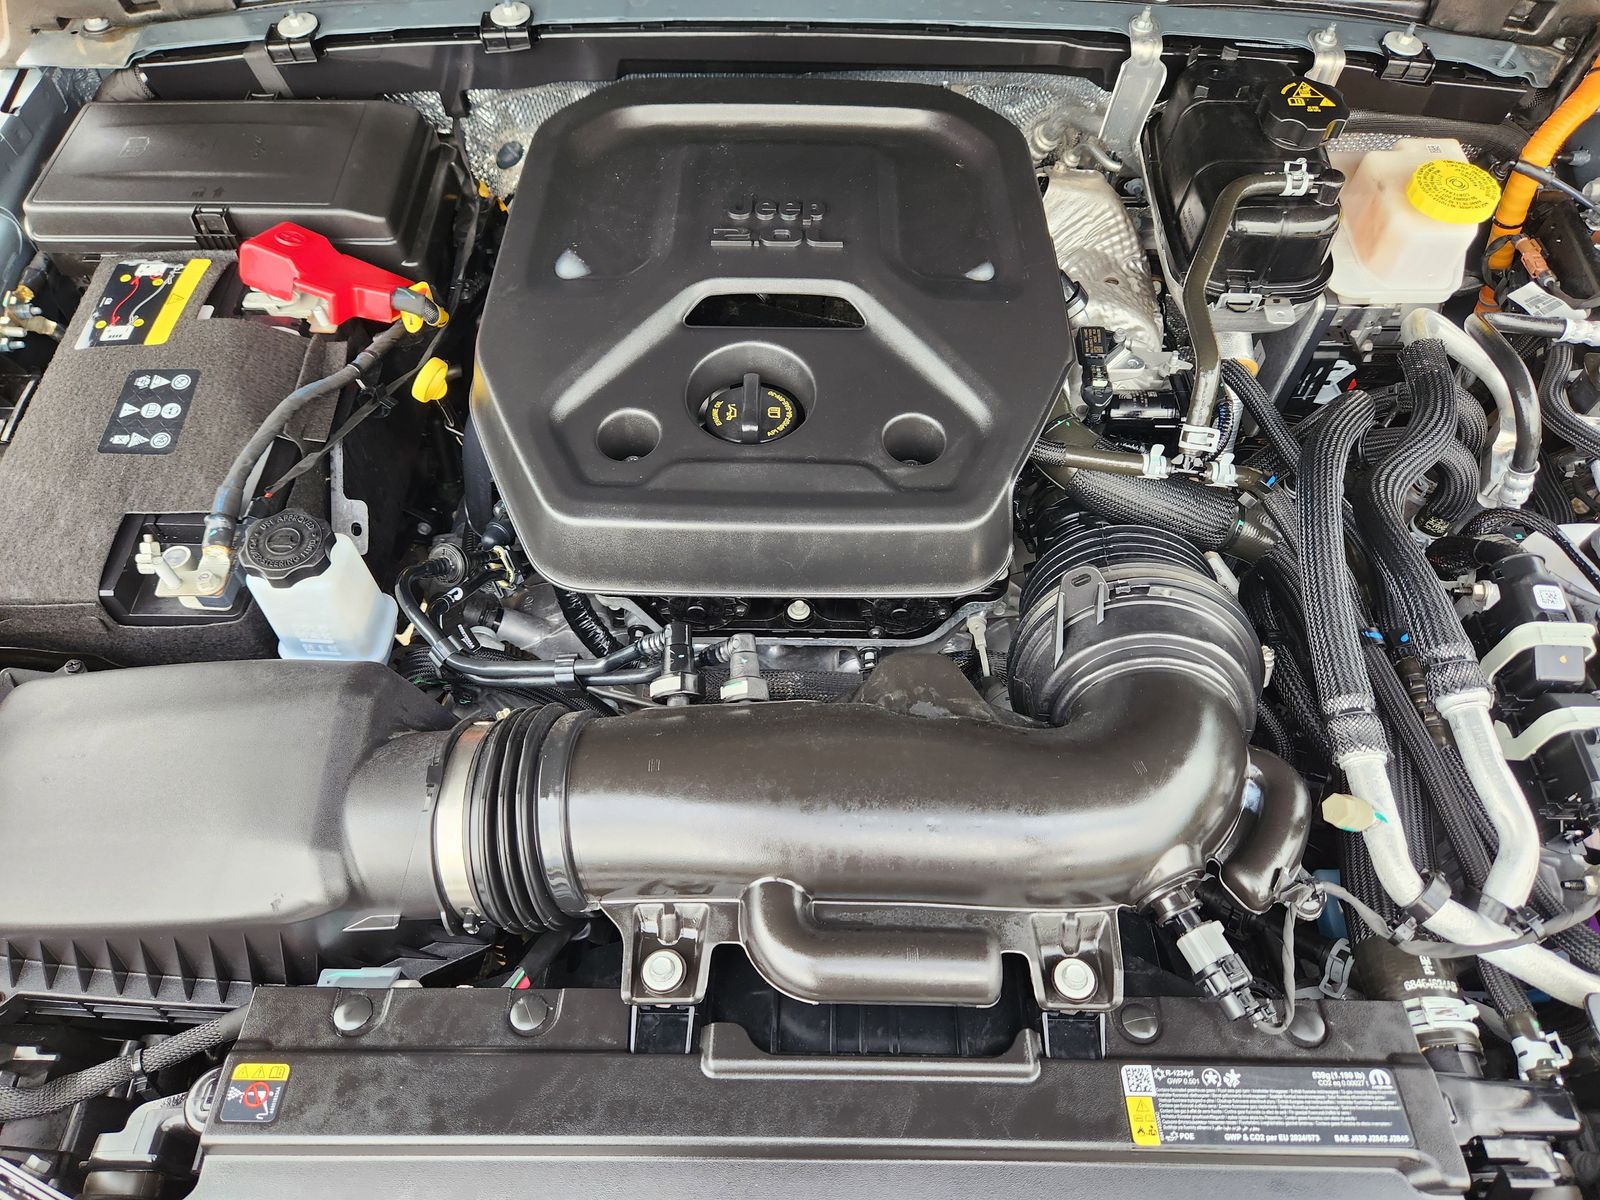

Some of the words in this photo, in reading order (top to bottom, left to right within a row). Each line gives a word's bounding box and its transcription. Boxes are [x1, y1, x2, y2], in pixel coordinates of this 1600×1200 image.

[727, 197, 826, 226] Jeep
[710, 227, 844, 248] 2.0L
[713, 400, 724, 408] OIL
[711, 408, 723, 427] ENGINE
[259, 519, 276, 531] USE
[276, 514, 315, 531] APPROVED
[260, 555, 300, 568] STEERING
[1165, 1068, 1194, 1078] R-1234yf
[1167, 1078, 1183, 1086] GWP
[1179, 1132, 1196, 1141] POE
[1224, 1133, 1242, 1142] GWP
[1249, 1133, 1265, 1142] CO2
[1278, 1133, 1290, 1142] EU
[1334, 1134, 1350, 1143] SAE
